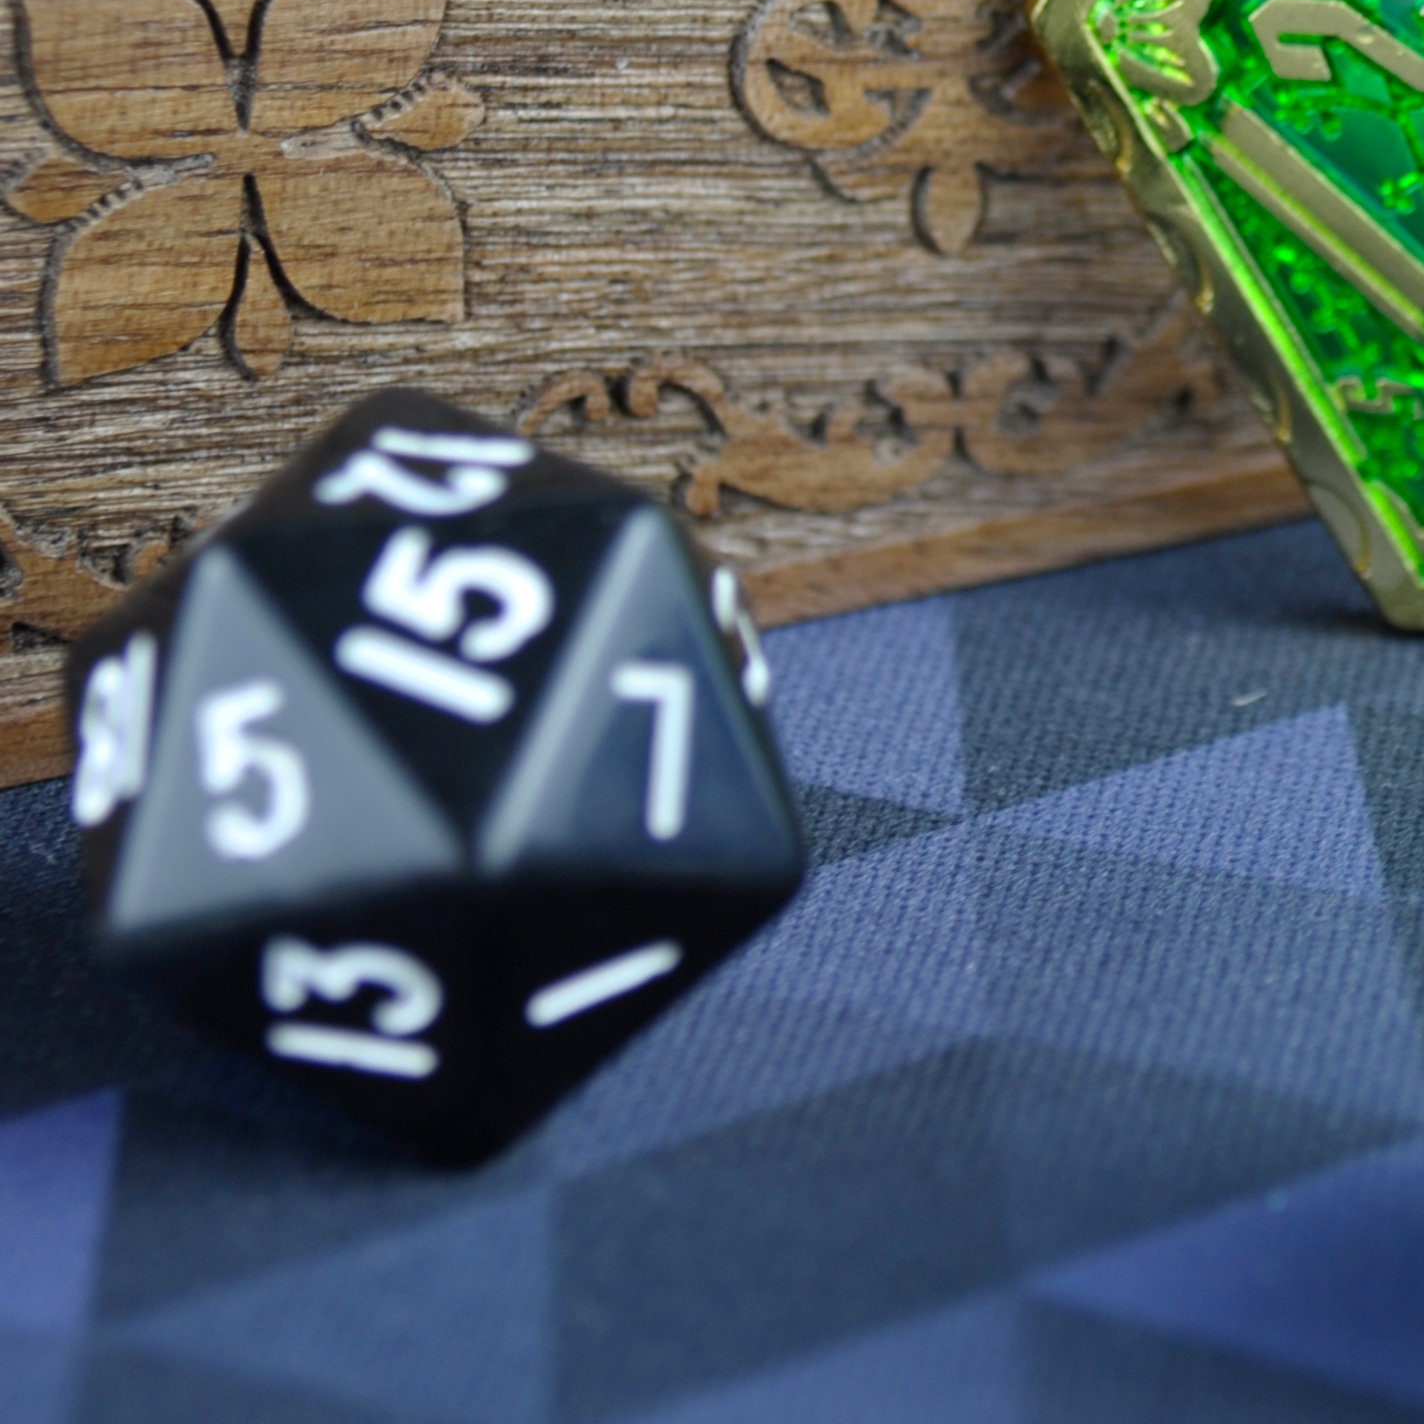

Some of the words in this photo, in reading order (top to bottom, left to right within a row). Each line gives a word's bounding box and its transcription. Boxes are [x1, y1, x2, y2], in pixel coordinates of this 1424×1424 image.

[313, 426, 536, 518] 12
[334, 526, 556, 724] 15
[199, 677, 311, 860] 5
[610, 662, 695, 840] 7
[261, 934, 444, 1079] 13
[525, 939, 683, 1029] 1
